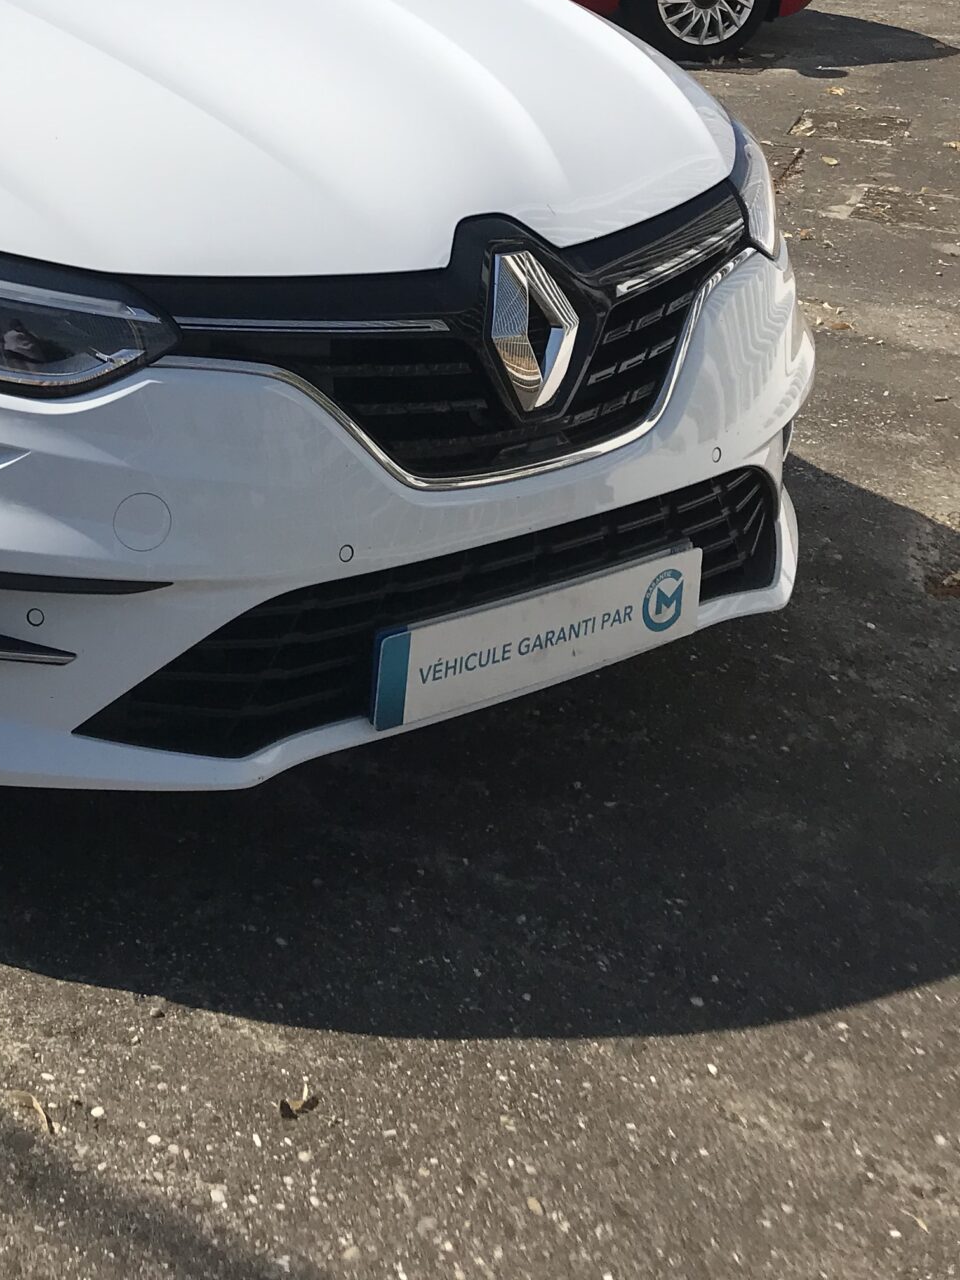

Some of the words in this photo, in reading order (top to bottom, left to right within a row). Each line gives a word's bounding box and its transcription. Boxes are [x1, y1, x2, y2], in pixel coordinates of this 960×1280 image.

[419, 642, 513, 685] VÉHICULE
[518, 617, 596, 655] GARANTI
[601, 604, 634, 631] PAR
